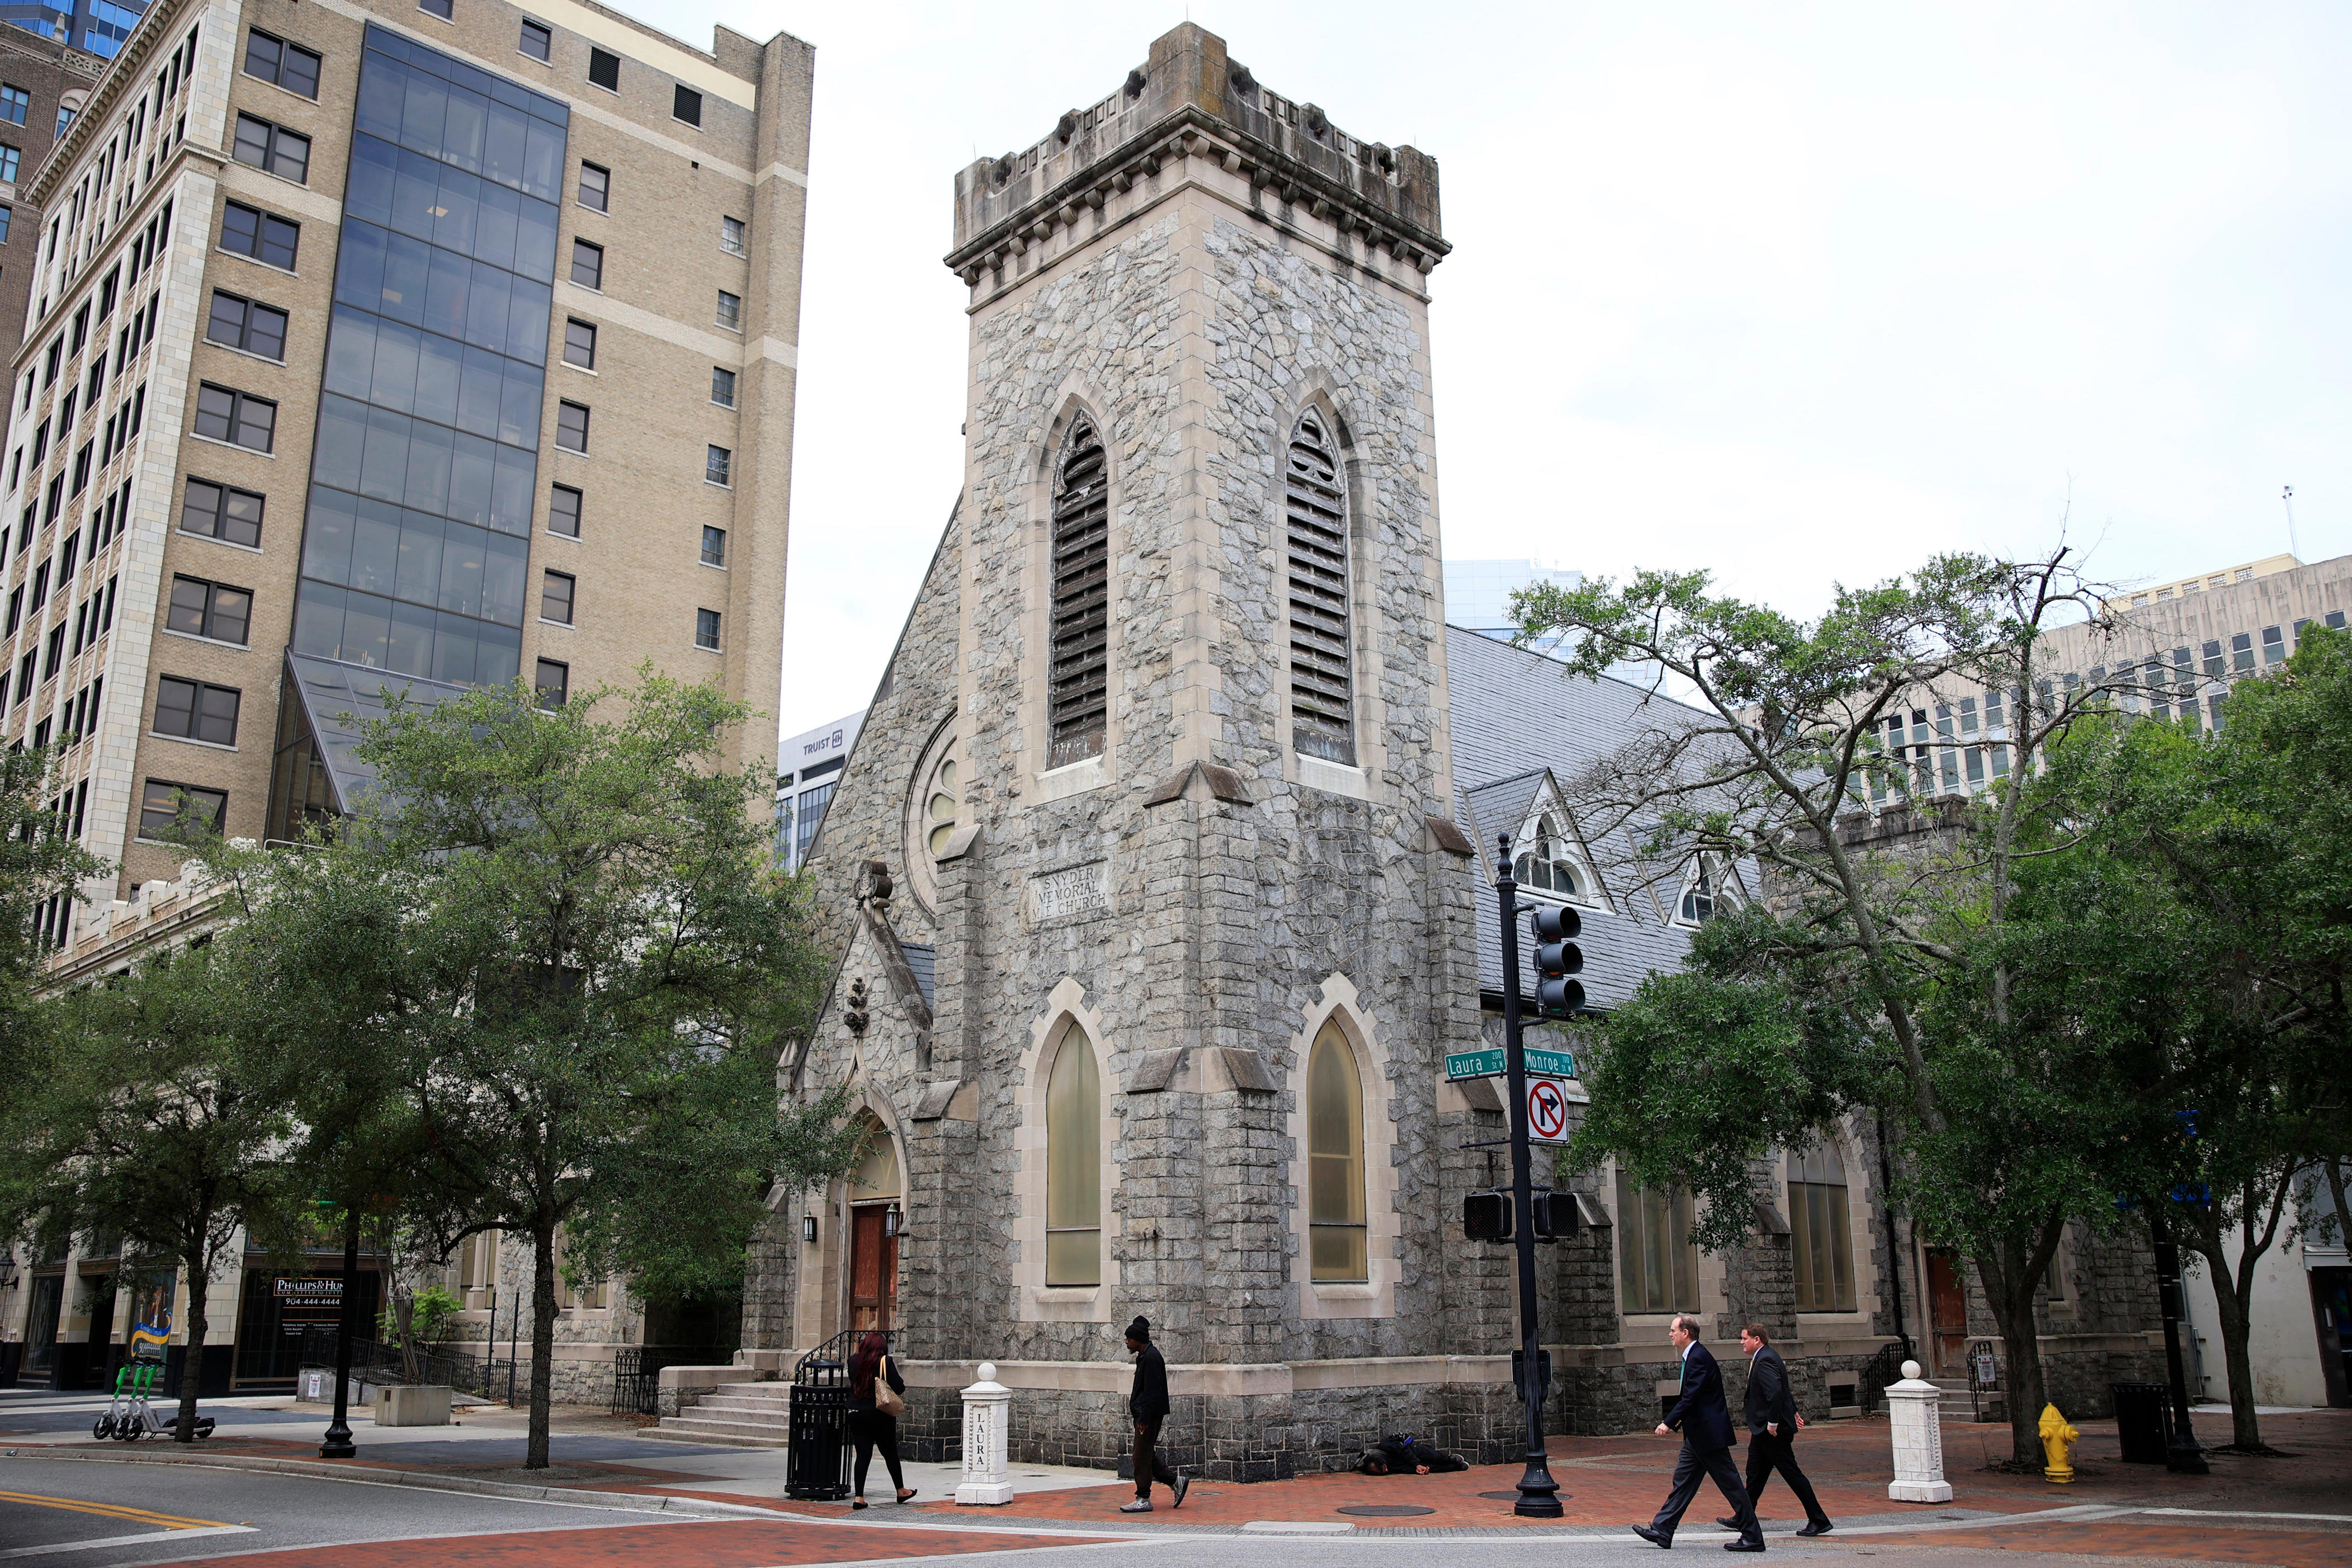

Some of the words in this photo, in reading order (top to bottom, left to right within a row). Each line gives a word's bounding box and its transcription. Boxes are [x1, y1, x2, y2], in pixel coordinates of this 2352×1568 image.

[803, 737, 830, 755] TRUIST
[1044, 867, 1094, 889] SNYDER
[1038, 881, 1098, 904] MEMORIAL
[1058, 893, 1106, 914] CHURCH
[1491, 1051, 1501, 1060] 200
[1524, 1051, 1558, 1071] Monroe
[1448, 1059, 1482, 1075] Laura
[277, 1279, 317, 1290] PHILLIPS
[317, 1279, 324, 1290] &
[976, 1413, 985, 1465] LAURA
